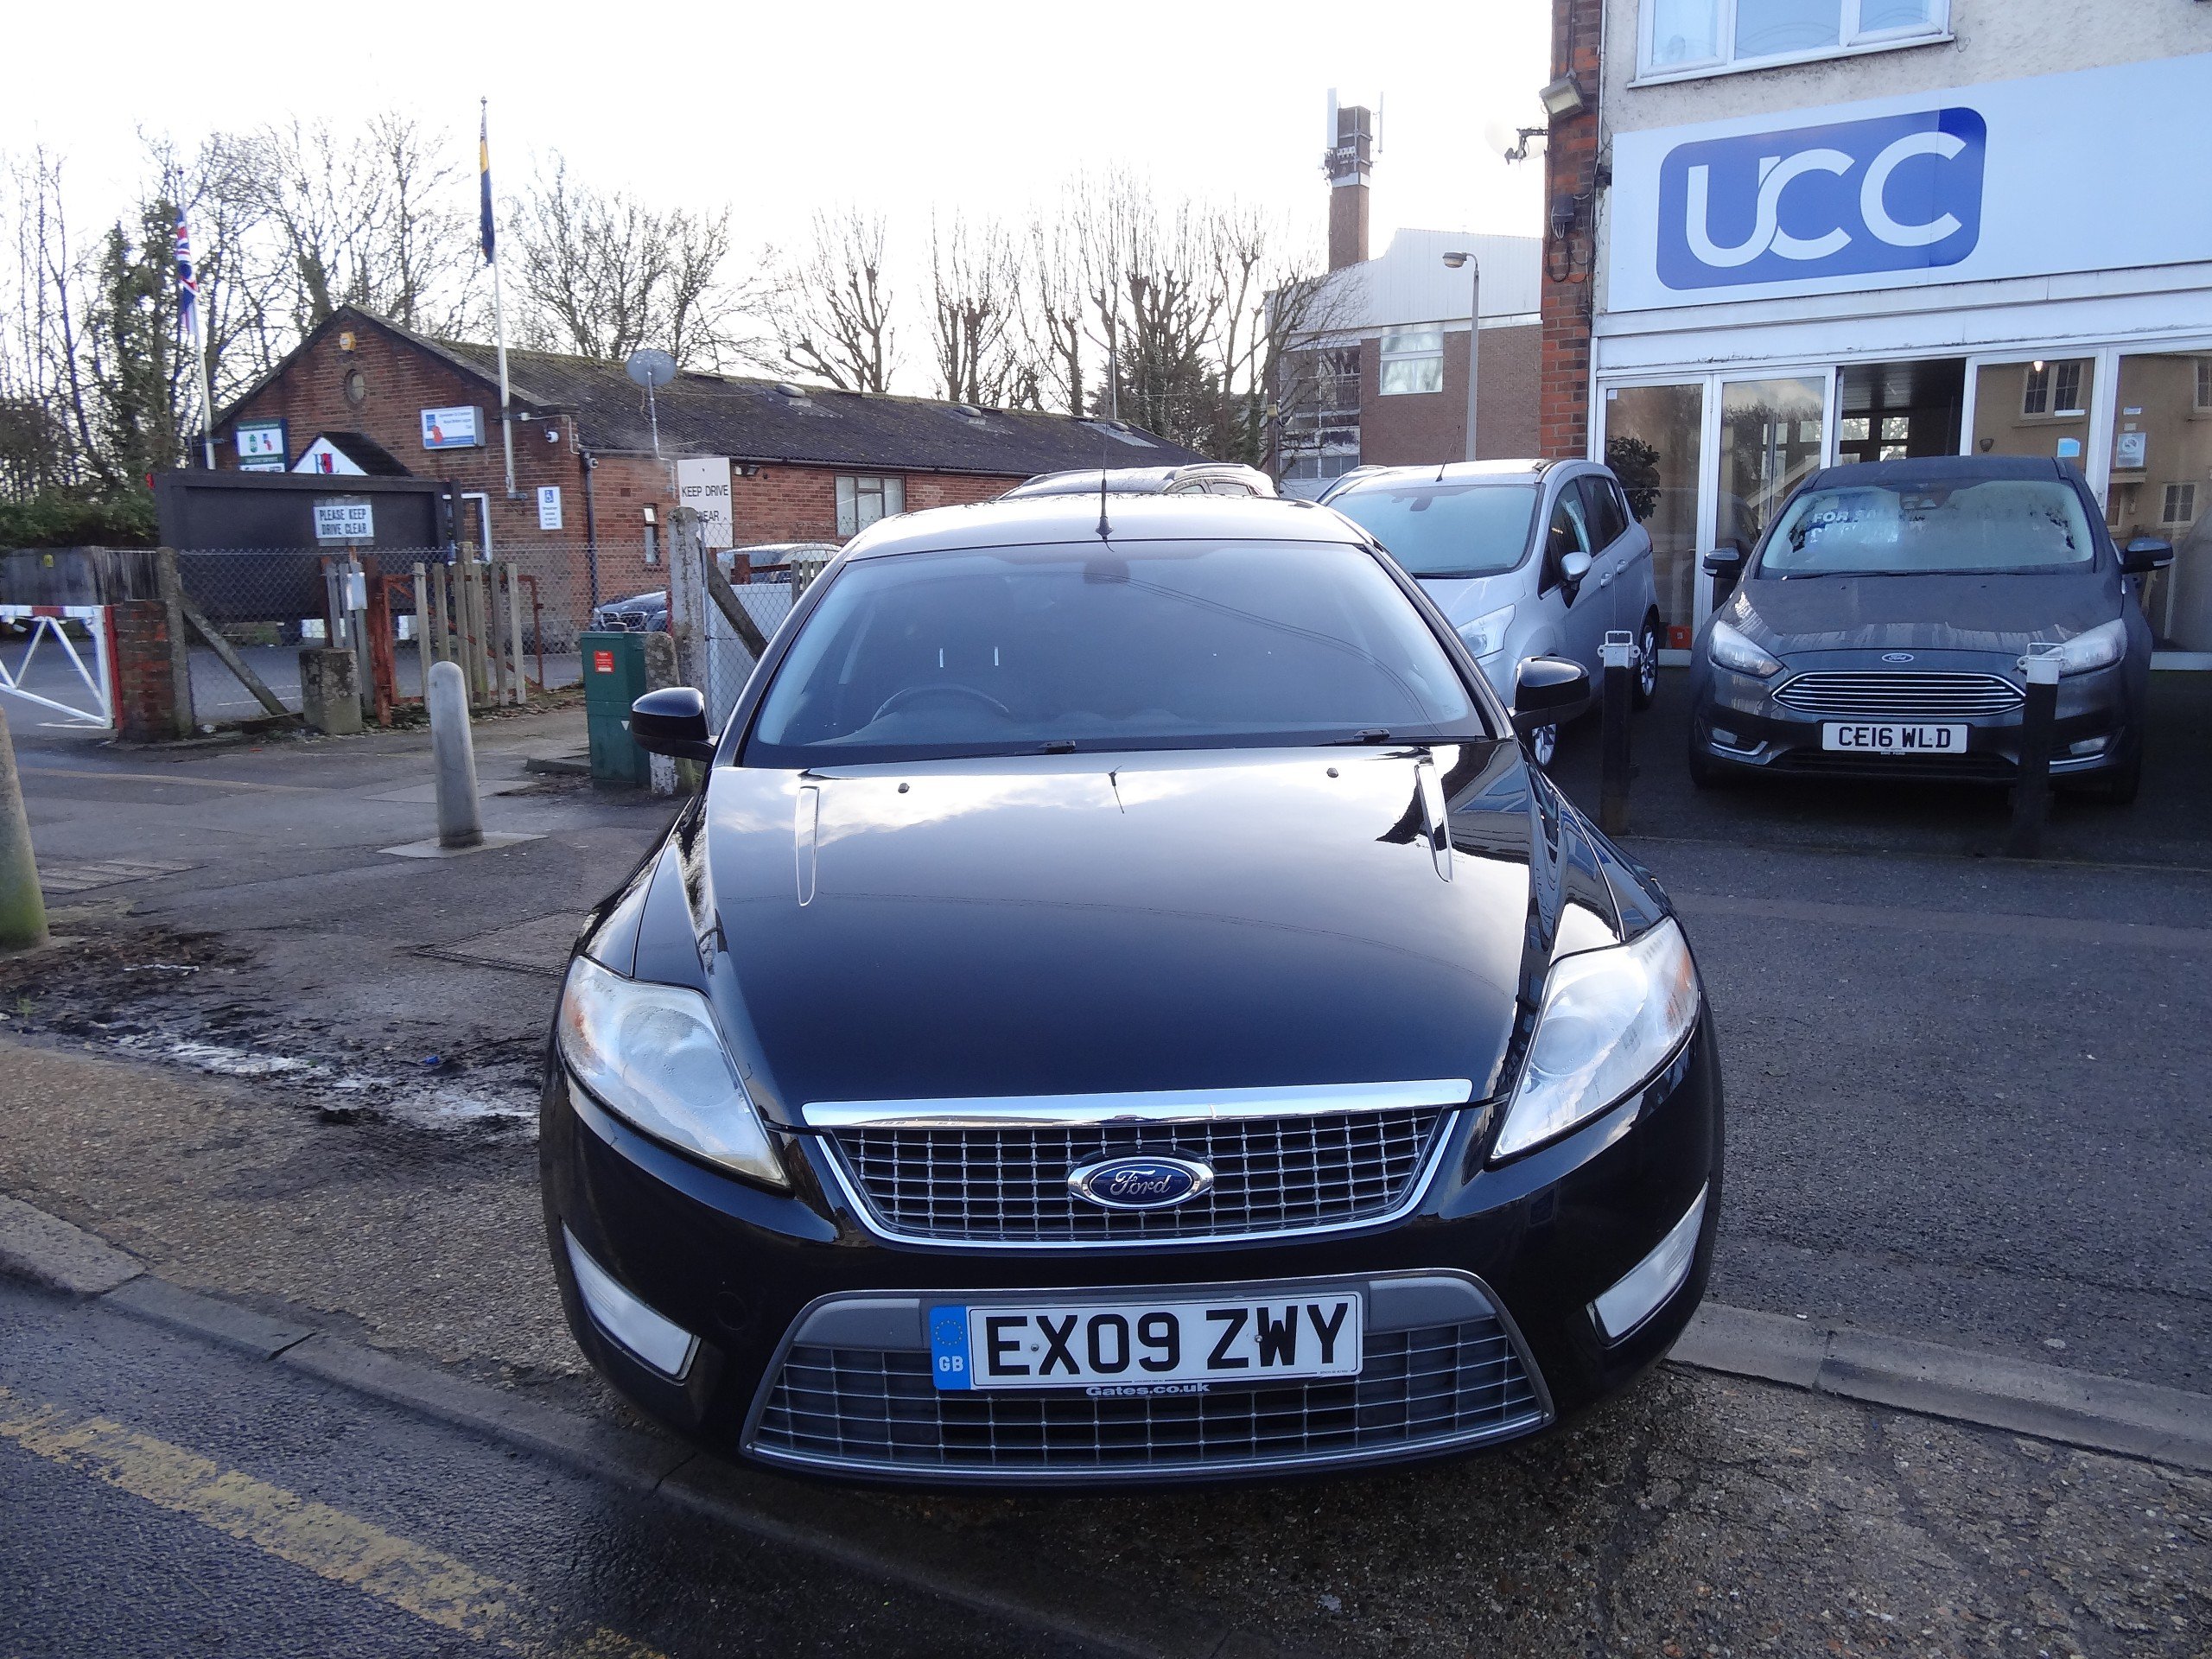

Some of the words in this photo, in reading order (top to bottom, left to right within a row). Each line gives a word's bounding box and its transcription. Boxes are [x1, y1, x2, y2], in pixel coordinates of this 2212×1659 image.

[1686, 130, 1967, 270] UCC
[681, 486, 702, 498] KEEP
[705, 485, 729, 497] DRIVE
[319, 508, 346, 521] PLEASE
[348, 508, 367, 520] KEEP
[698, 510, 720, 522] EAR
[1812, 510, 1849, 524] FOR
[321, 523, 342, 535] DRIVE
[345, 522, 367, 535] CLEAR
[1838, 726, 1893, 747] CE16
[1902, 728, 1952, 749] WLD
[1109, 1169, 1173, 1196] Ford
[984, 1311, 1181, 1376] EX09
[1205, 1302, 1349, 1370] ZWY
[938, 1355, 964, 1374] GB
[1085, 1382, 1211, 1397] Gates.co.uk
